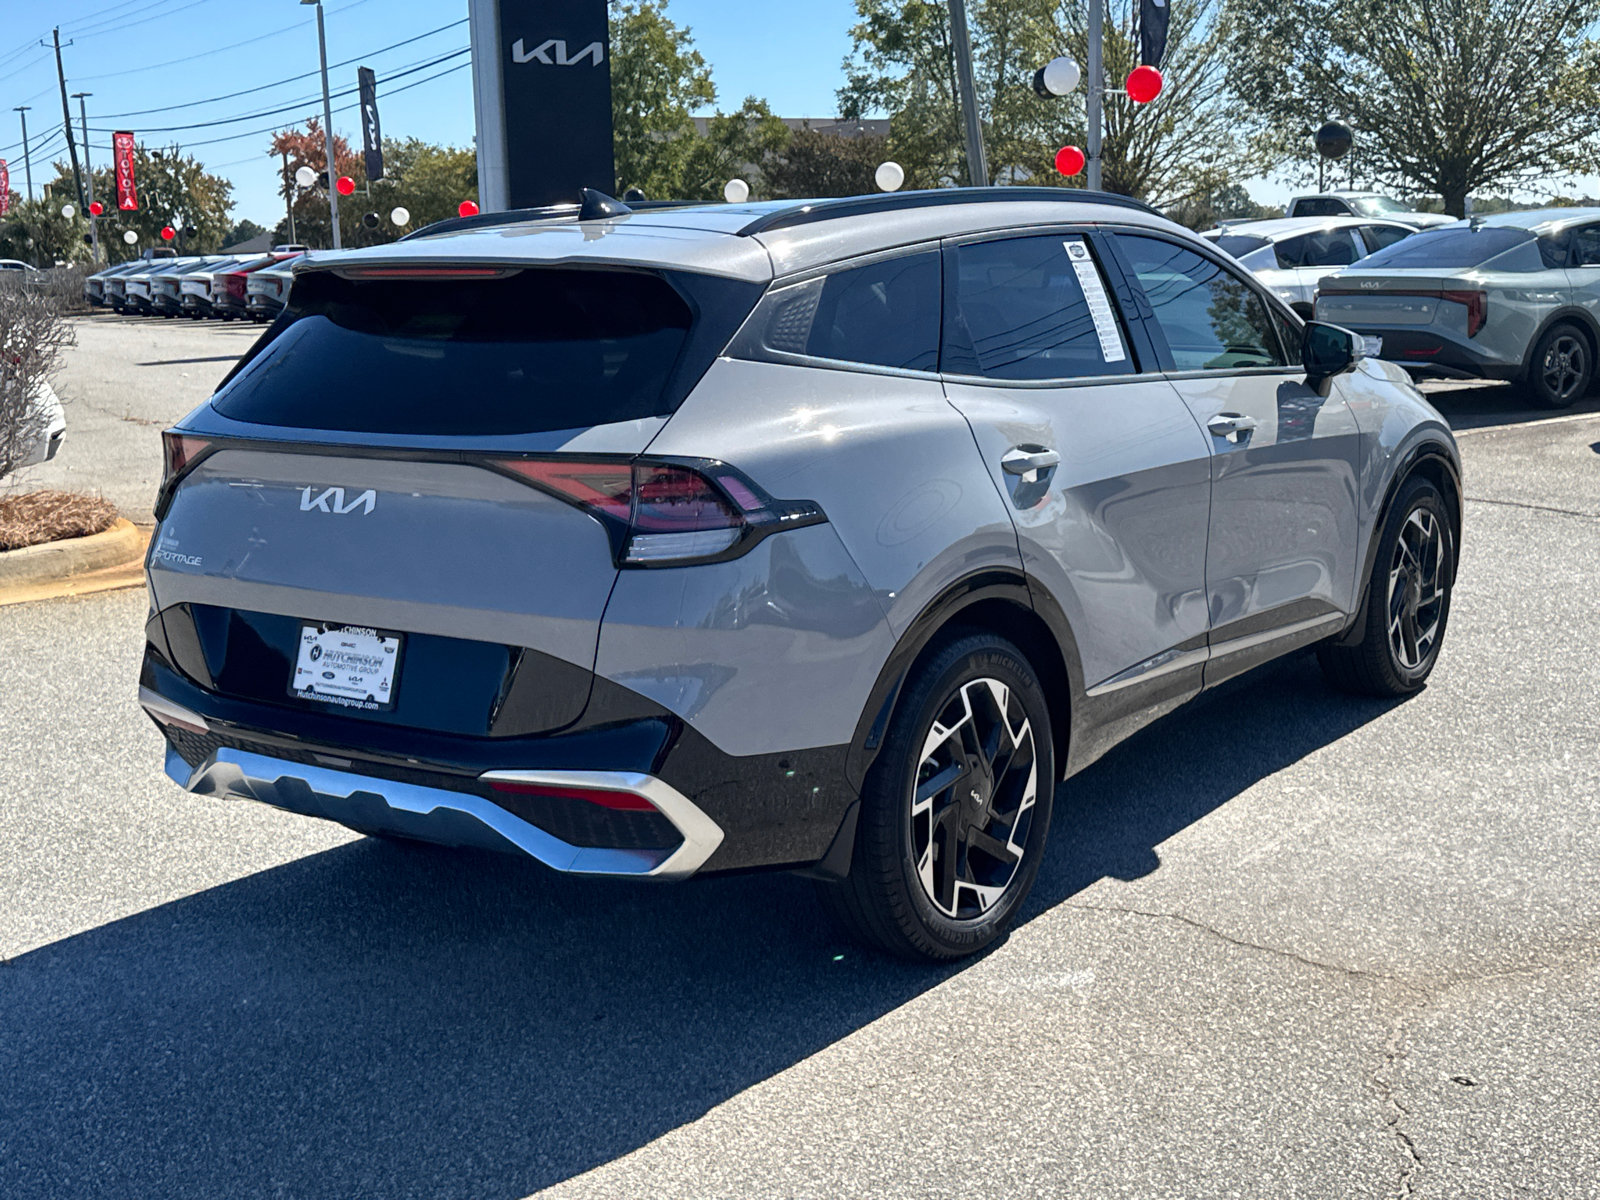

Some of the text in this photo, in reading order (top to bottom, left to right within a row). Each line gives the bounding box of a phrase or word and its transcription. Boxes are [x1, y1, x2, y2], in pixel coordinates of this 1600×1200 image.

[511, 38, 604, 67] KIA
[119, 149, 135, 208] TOYOTA
[1360, 281, 1380, 289] KIA
[299, 485, 377, 515] KIA
[322, 661, 358, 673] AUTOMOTIVE
[358, 664, 380, 675] GROUP
[990, 652, 1032, 687] MICHELIN
[297, 690, 379, 709] Hutchinsonautogroup.com
[970, 789, 983, 806] KIA
